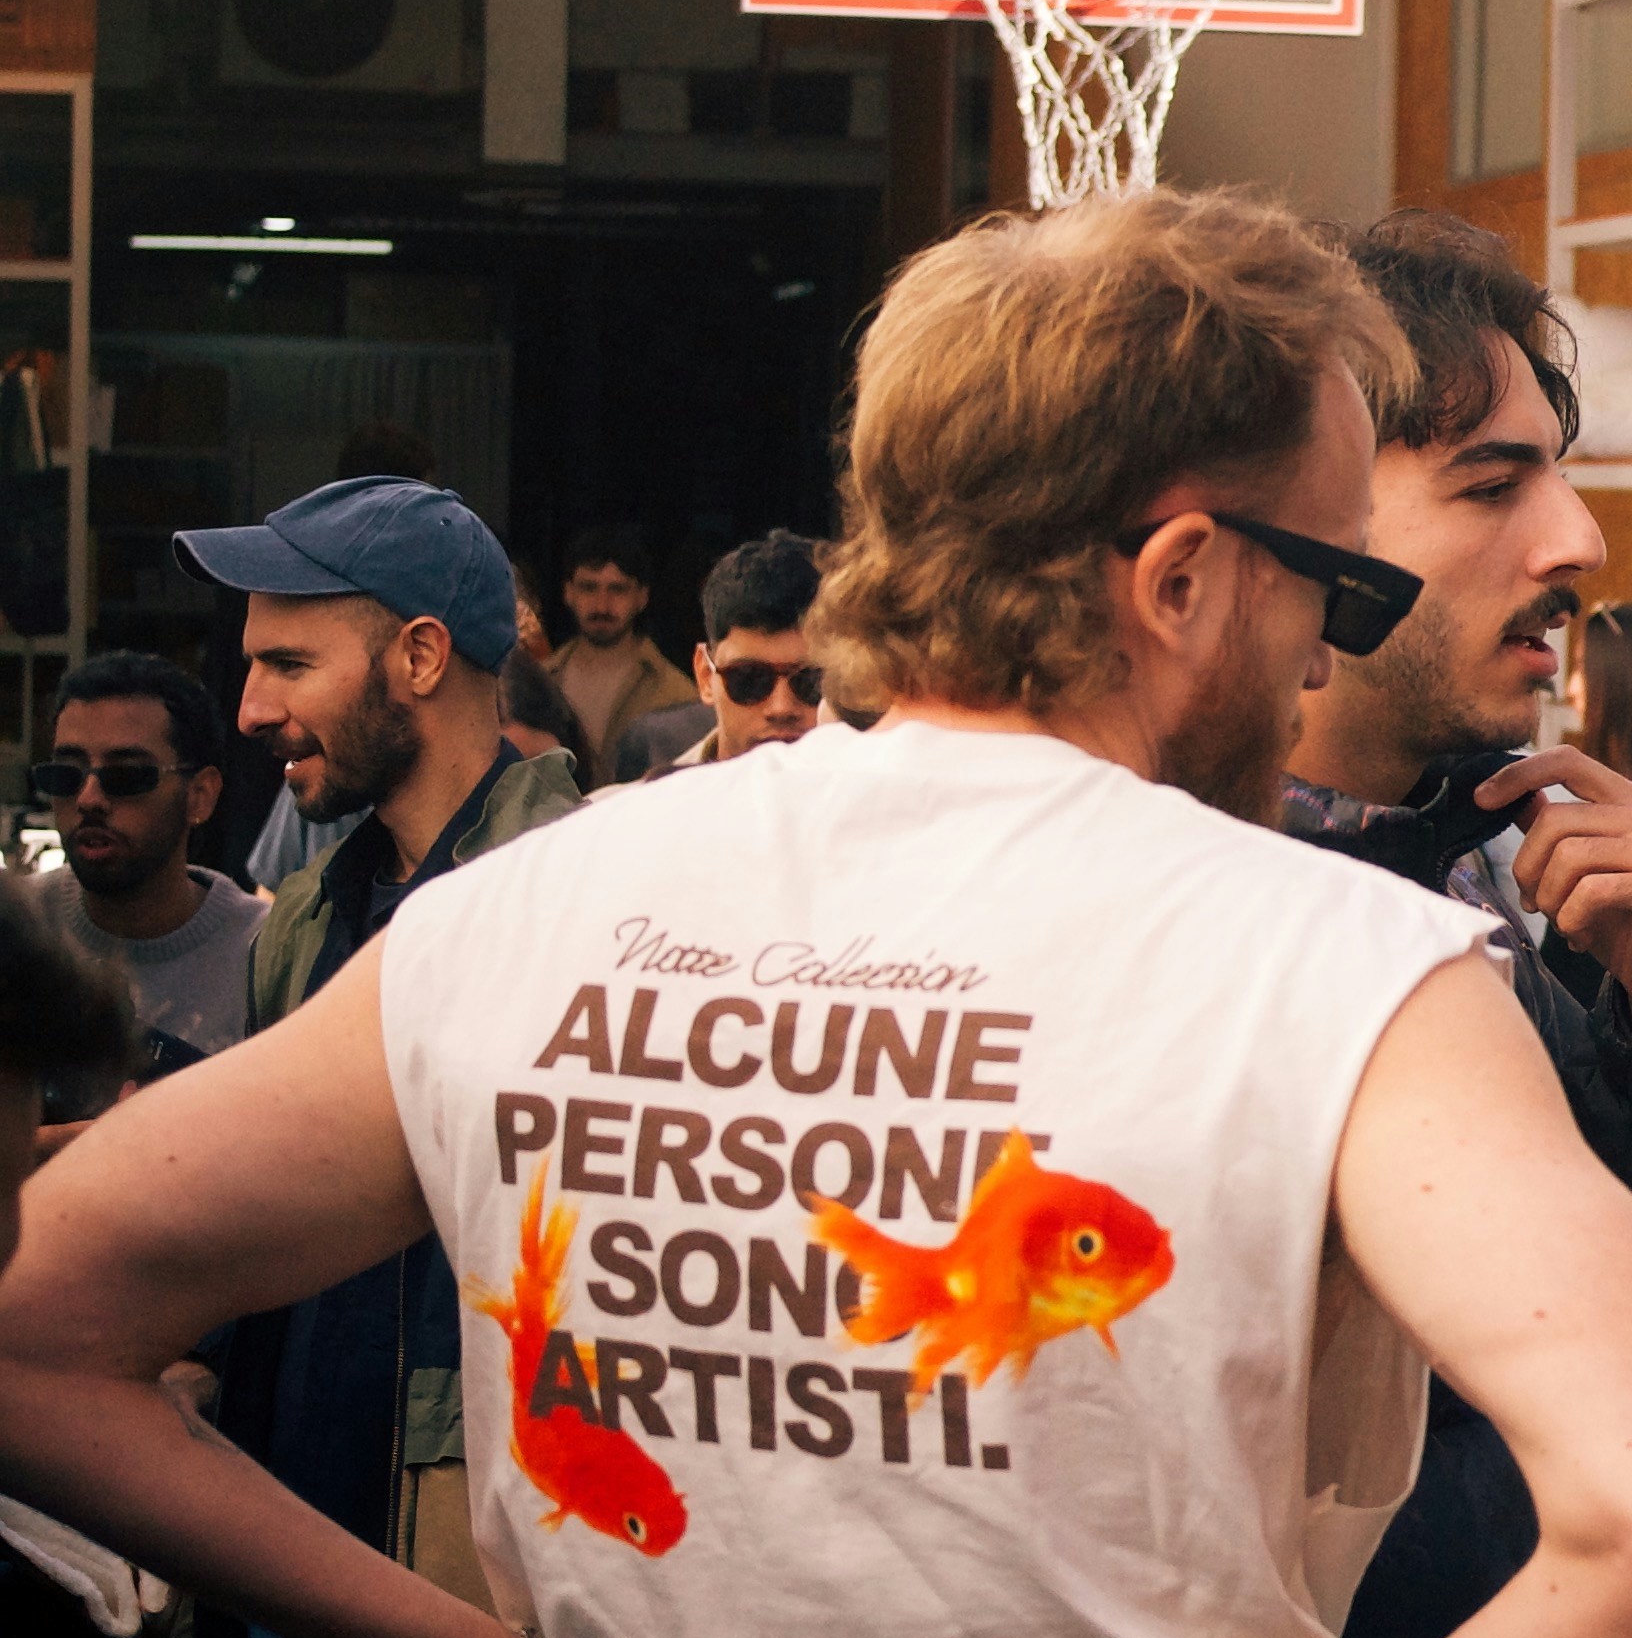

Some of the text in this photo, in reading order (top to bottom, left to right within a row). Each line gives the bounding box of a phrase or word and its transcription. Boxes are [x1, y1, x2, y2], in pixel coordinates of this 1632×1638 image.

[614, 917, 989, 995] Notte Collection
[533, 984, 1033, 1103] ALCUNE
[528, 1329, 1010, 1470] ARTISTI.
